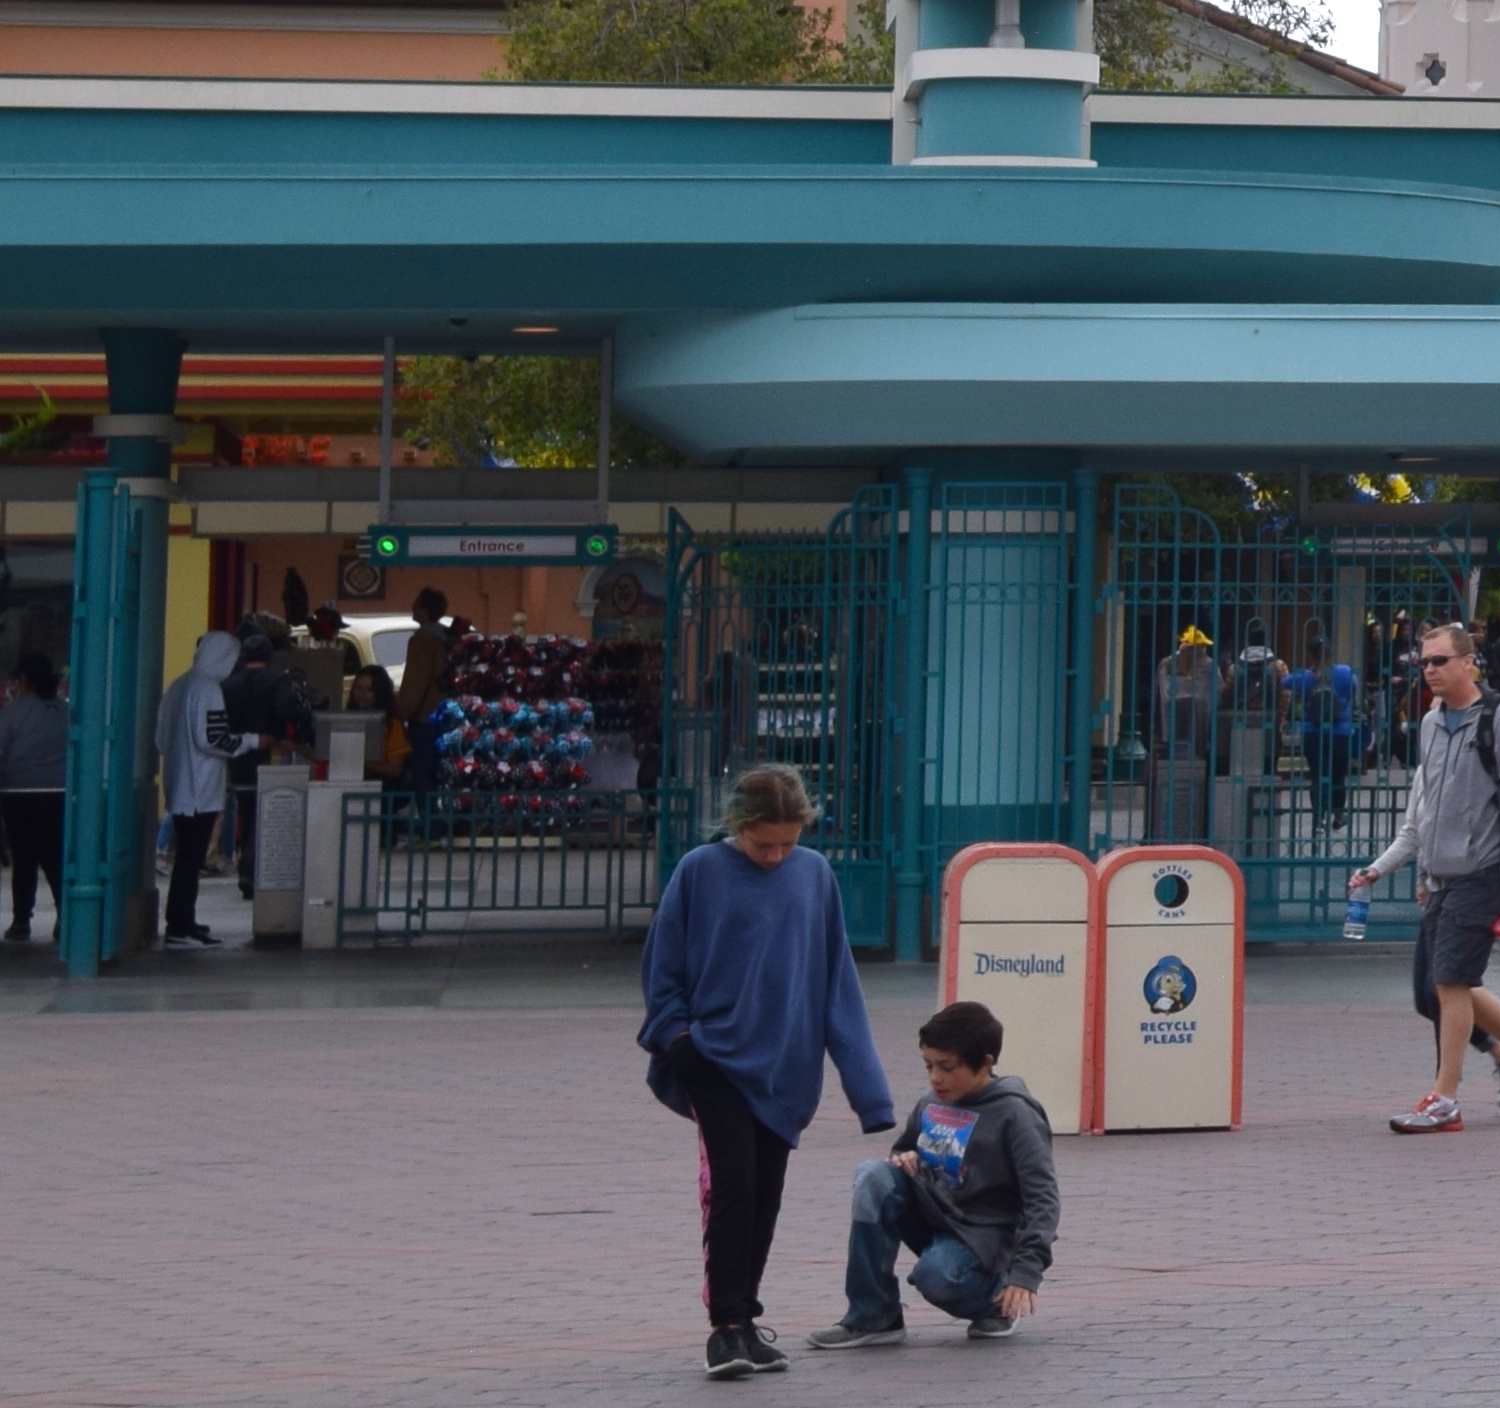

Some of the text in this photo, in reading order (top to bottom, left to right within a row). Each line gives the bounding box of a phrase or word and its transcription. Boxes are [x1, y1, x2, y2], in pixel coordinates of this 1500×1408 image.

[459, 539, 525, 553] Entrance
[1151, 865, 1193, 880] BOTTLES
[1158, 909, 1185, 918] CANS
[973, 952, 1065, 978] Disneyland
[1140, 1020, 1197, 1032] RECYCLE
[1143, 1033, 1193, 1045] PLEASE
